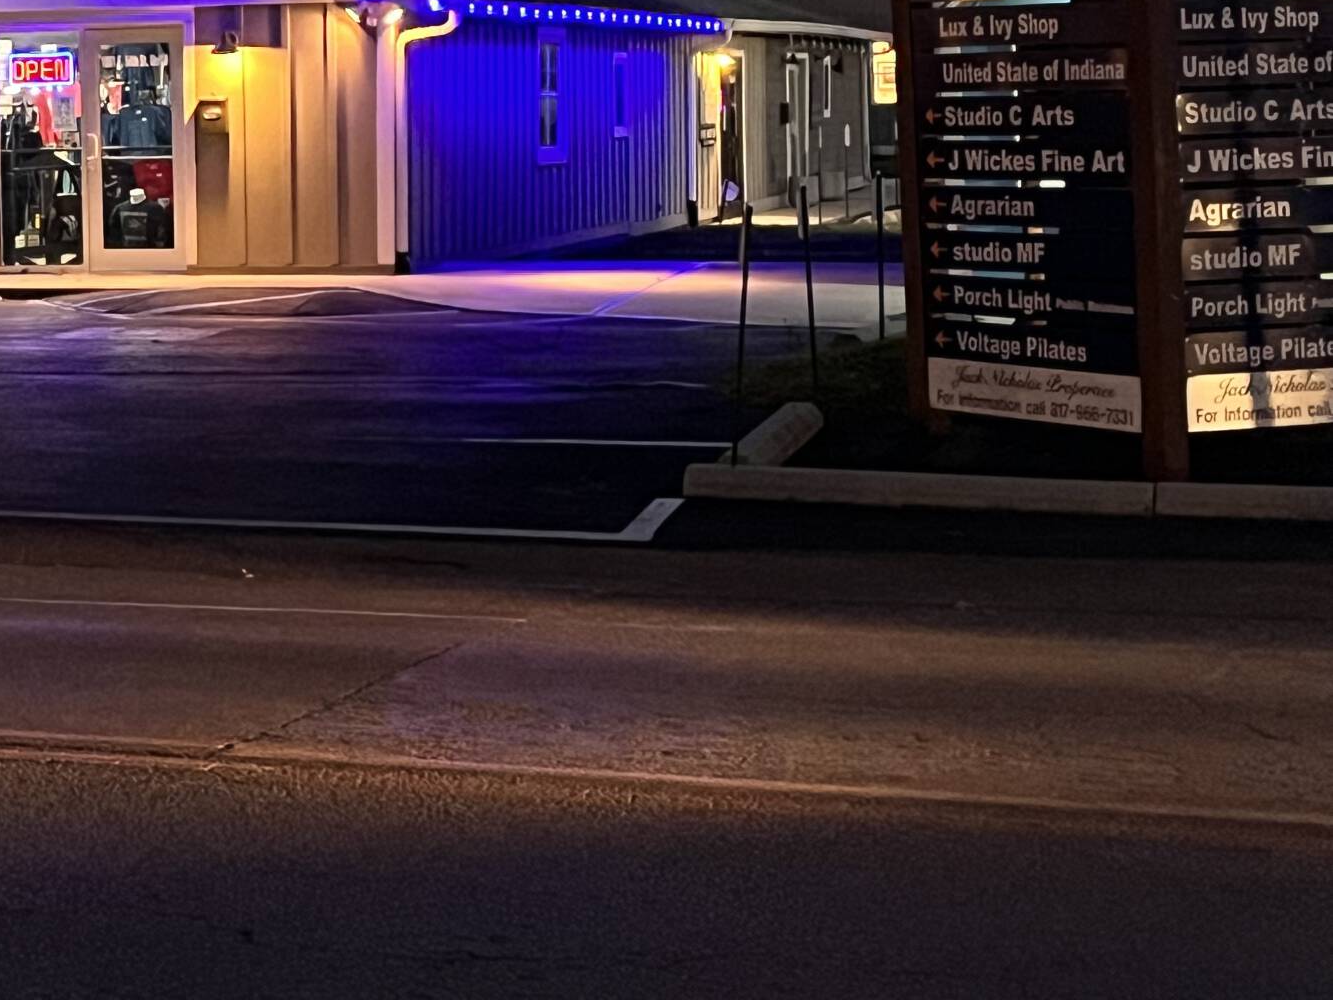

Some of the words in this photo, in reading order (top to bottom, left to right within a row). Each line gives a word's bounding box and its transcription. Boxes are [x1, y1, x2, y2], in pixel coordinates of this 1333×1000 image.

[939, 17, 968, 38] Lux
[973, 15, 984, 36] &
[990, 14, 1013, 41] Ivy
[1018, 13, 1059, 39] Shop
[1180, 8, 1215, 30] Lux
[1221, 6, 1234, 29] &
[1241, 7, 1268, 34] Ivy
[1274, 6, 1319, 32] Shop
[13, 58, 69, 81] OPEN
[942, 62, 992, 84] United
[996, 61, 1038, 82] State
[1043, 59, 1059, 81] of
[1064, 58, 1125, 81] Indiana
[1182, 54, 1249, 77] United
[1256, 53, 1309, 75] State
[1314, 51, 1333, 72] of
[944, 105, 1003, 126] Studio
[1009, 105, 1022, 126] C
[1031, 105, 1075, 126] Arts
[1185, 101, 1257, 124] Studio
[1264, 100, 1278, 121] C
[1290, 99, 1333, 121] Arts
[948, 150, 959, 171] J
[965, 150, 1035, 171] Wickes
[1041, 150, 1085, 172] Fine
[1092, 150, 1126, 173] Art
[1187, 150, 1201, 173] J
[1208, 147, 1294, 172] Wickes
[1302, 146, 1333, 168] Fin
[951, 194, 1035, 220] Agrarian
[1189, 196, 1291, 226] Agrarian
[953, 241, 1012, 262] studio
[1017, 243, 1045, 263] MF
[1190, 246, 1262, 270] studio
[1268, 244, 1301, 266] MF
[954, 285, 1002, 307] Porch
[1008, 289, 1052, 314] Light
[1191, 295, 1248, 318] Porch
[1256, 293, 1306, 318] Light
[956, 330, 1021, 359] Voltage
[1026, 336, 1087, 362] Pilates
[1194, 343, 1274, 367] Voltage
[1281, 337, 1333, 360] Pilate
[1214, 377, 1253, 404] Jack
[1267, 371, 1326, 393] icholas
[1196, 408, 1217, 423] For
